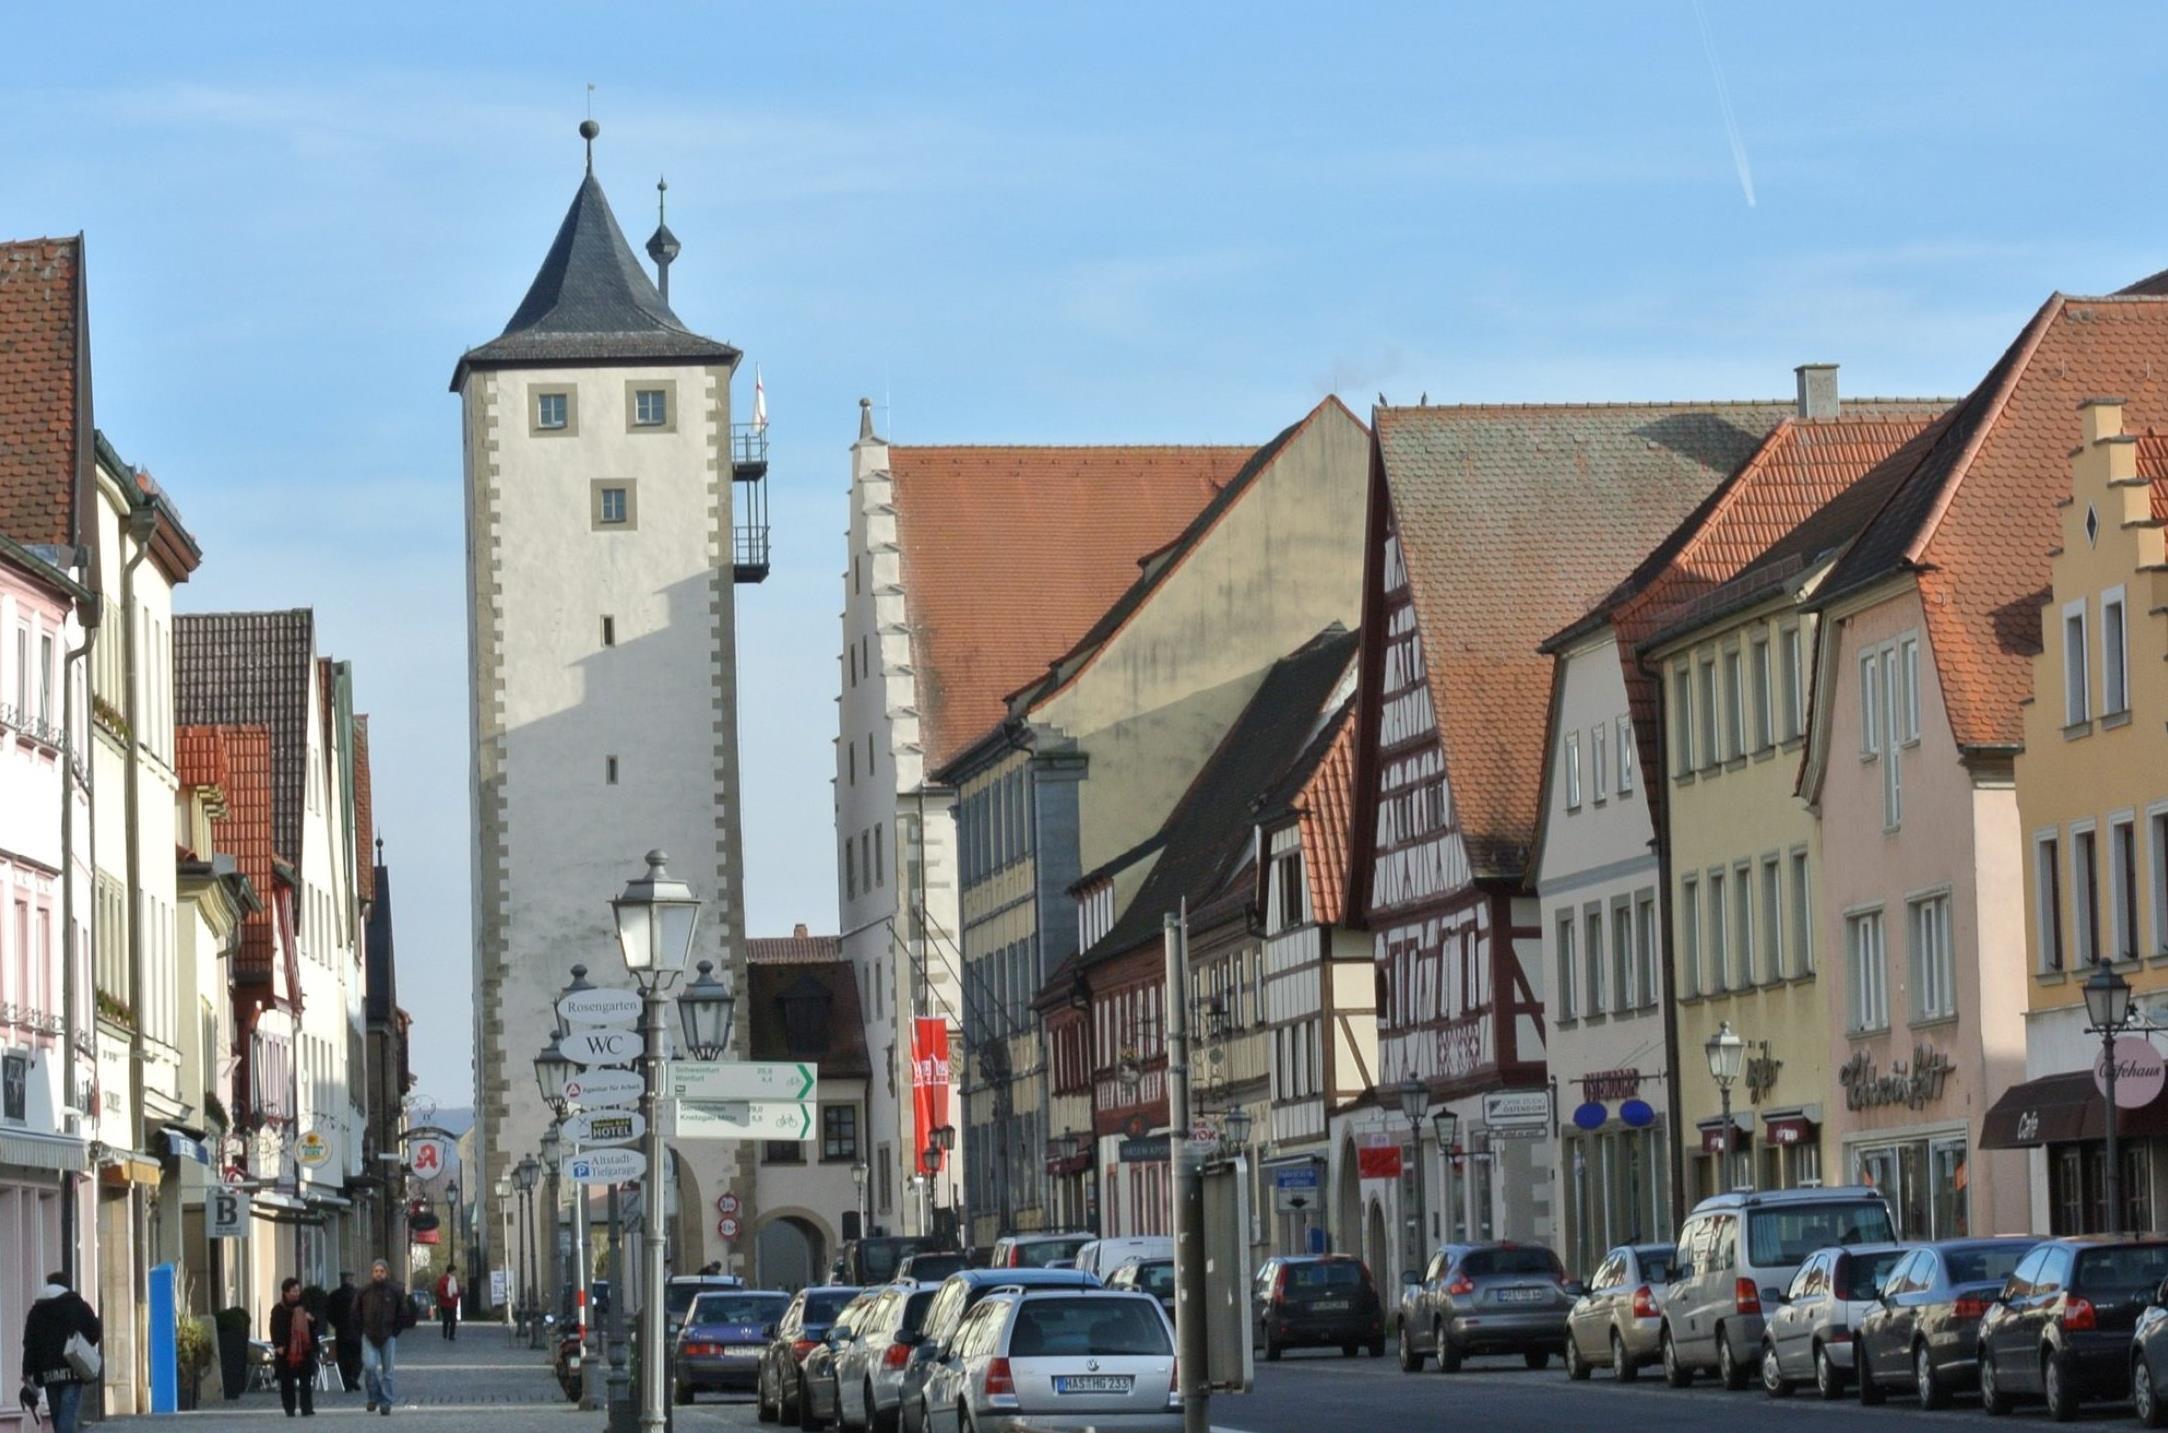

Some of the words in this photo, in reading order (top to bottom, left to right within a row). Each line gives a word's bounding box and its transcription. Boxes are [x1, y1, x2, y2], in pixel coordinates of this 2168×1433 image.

[568, 1001, 637, 1014] Rosengarten
[586, 1035, 623, 1055] WC
[2099, 1060, 2161, 1082] Cfehaus
[593, 1126, 632, 1138] HOTEL
[215, 1196, 237, 1225] B
